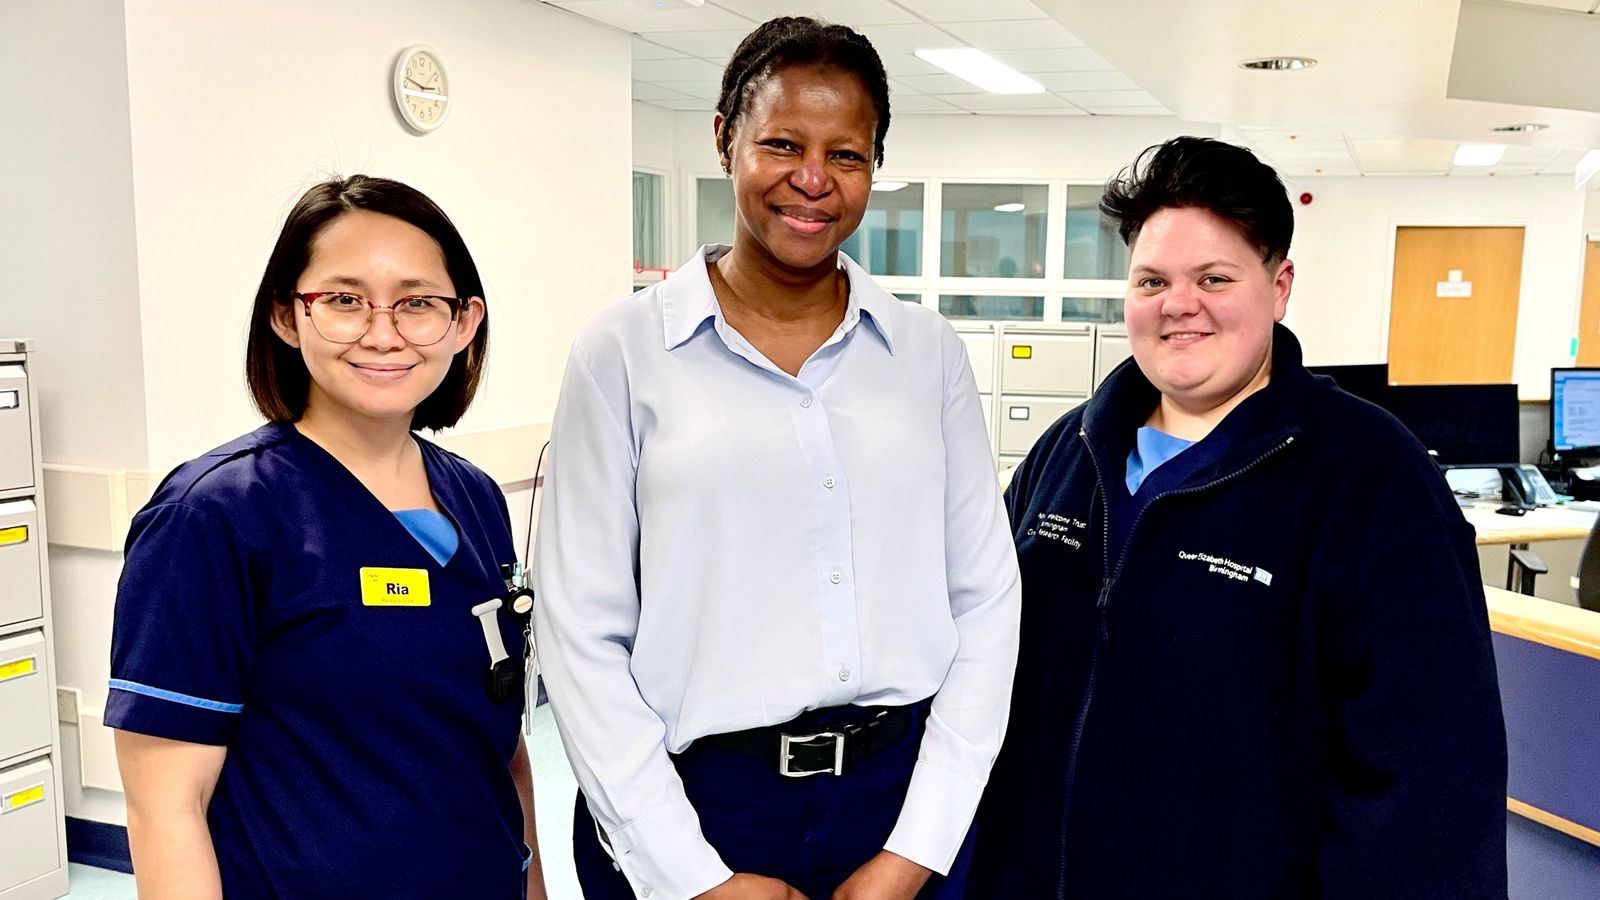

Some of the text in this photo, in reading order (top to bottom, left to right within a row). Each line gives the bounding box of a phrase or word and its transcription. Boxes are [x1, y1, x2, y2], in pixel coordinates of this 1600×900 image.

[418, 57, 425, 67] 12
[419, 109, 425, 119] 6
[1061, 534, 1082, 550] Facility
[1208, 563, 1249, 582] Birmingham
[1224, 558, 1253, 575] Hospital
[386, 582, 409, 595] Ria
